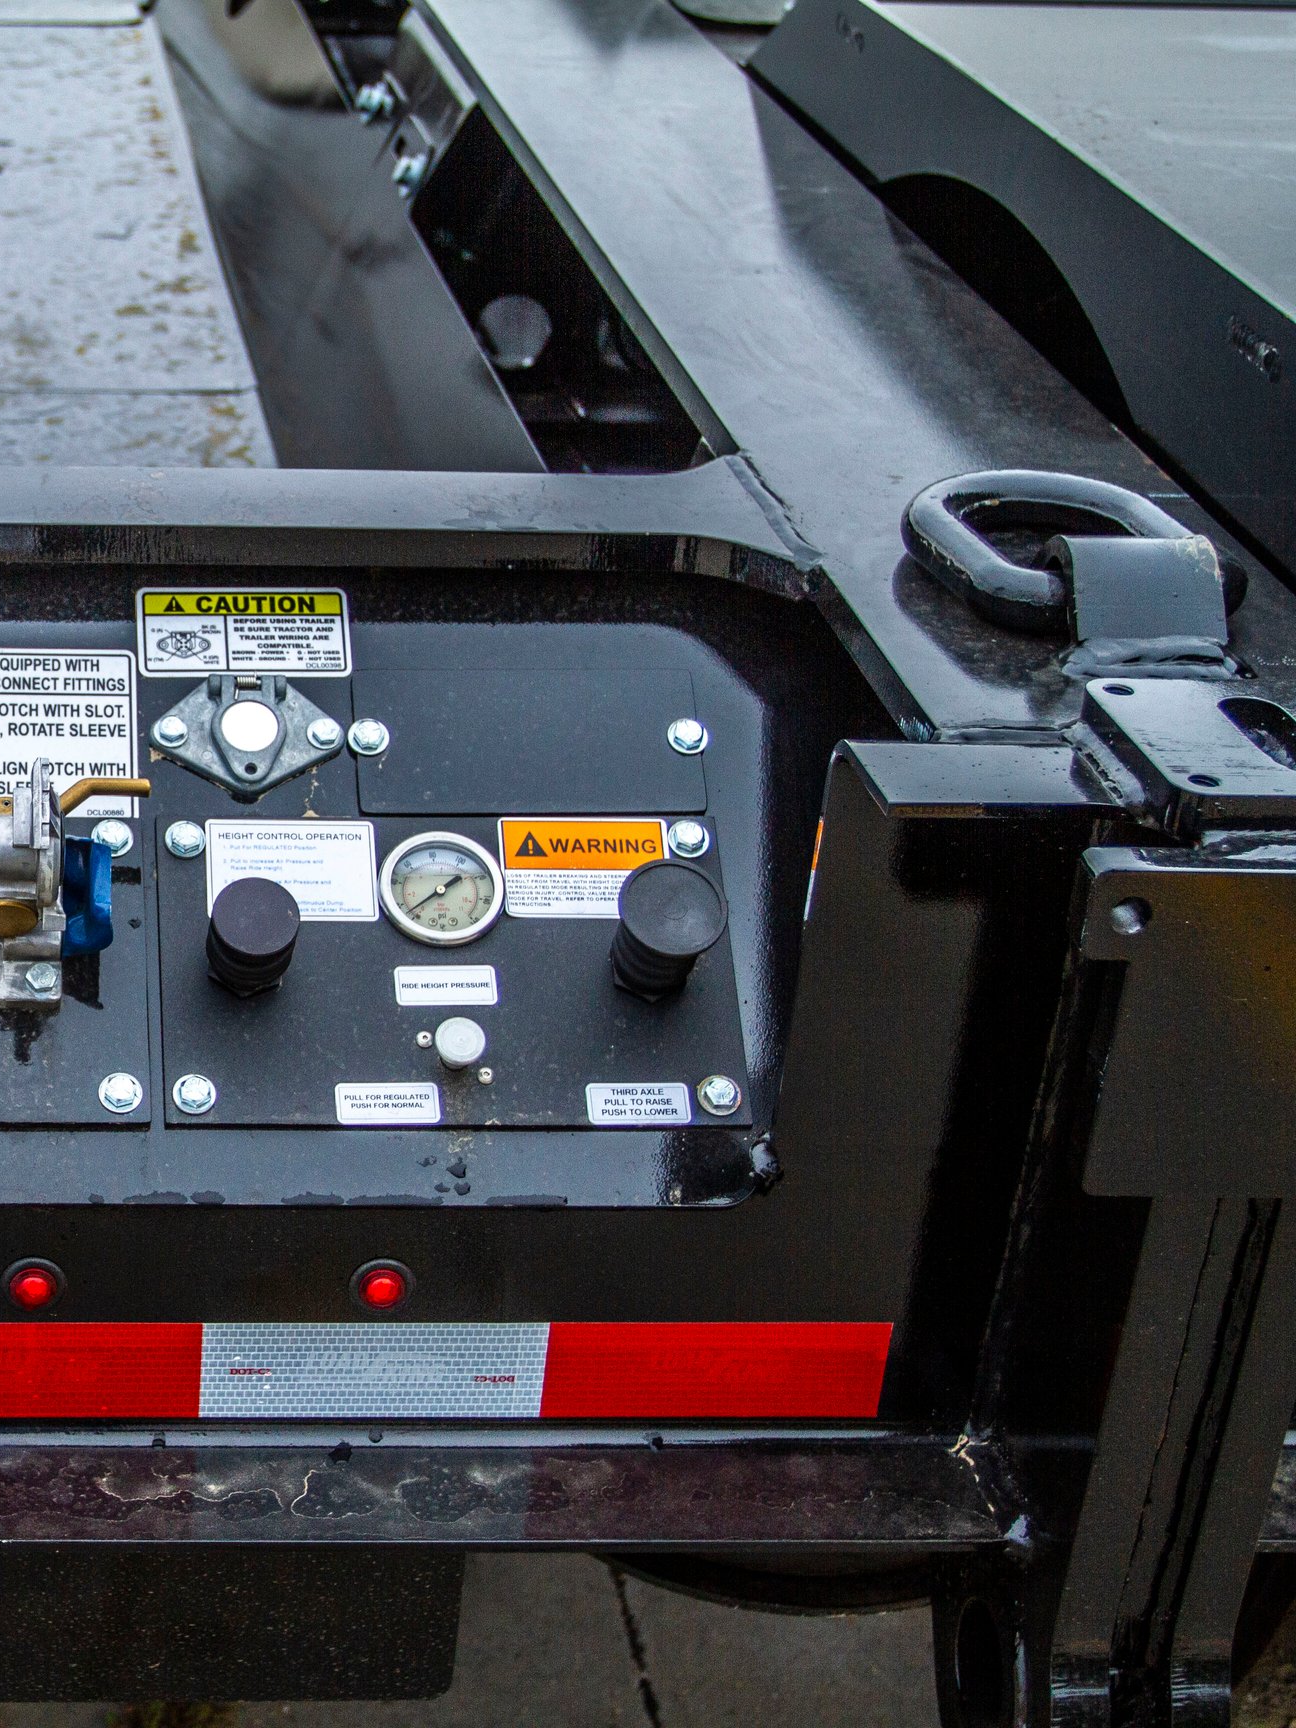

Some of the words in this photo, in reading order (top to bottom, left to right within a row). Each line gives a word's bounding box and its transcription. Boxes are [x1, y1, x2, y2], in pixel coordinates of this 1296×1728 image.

[195, 596, 316, 613] CAUTION
[65, 659, 99, 672] WITH
[63, 677, 126, 692] FITTINGS
[43, 704, 80, 717] WITH
[85, 704, 124, 718] SLOT.
[8, 723, 64, 736] ROTATE
[70, 724, 126, 737] SLEEVE
[47, 762, 84, 776] OTCH
[89, 763, 126, 776] WITH
[548, 838, 658, 855] WARNING
